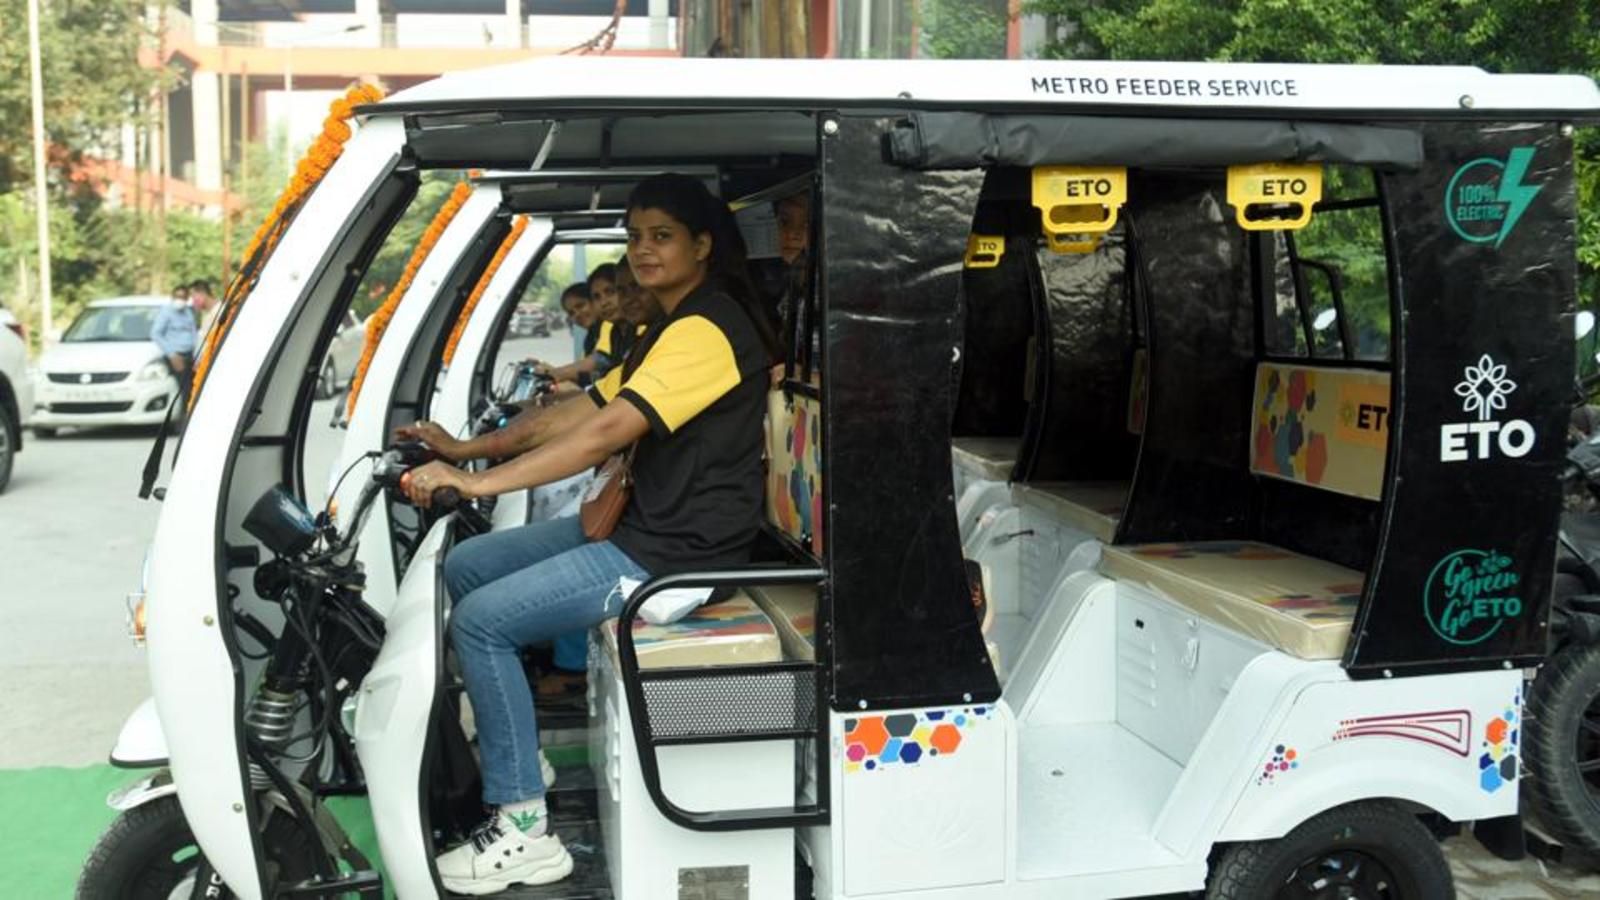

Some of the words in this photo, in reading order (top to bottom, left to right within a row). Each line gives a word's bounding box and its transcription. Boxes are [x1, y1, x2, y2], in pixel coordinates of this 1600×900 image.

[1031, 77, 1108, 95] METRO
[1116, 78, 1201, 96] FEEDER
[1208, 79, 1299, 97] SERVICE
[1067, 179, 1112, 197] ETO
[1262, 179, 1307, 196] ETO
[1459, 184, 1496, 203] 100%
[1456, 205, 1505, 221] ELECTRIC
[1357, 404, 1391, 432] ET
[1440, 418, 1536, 462] ETO
